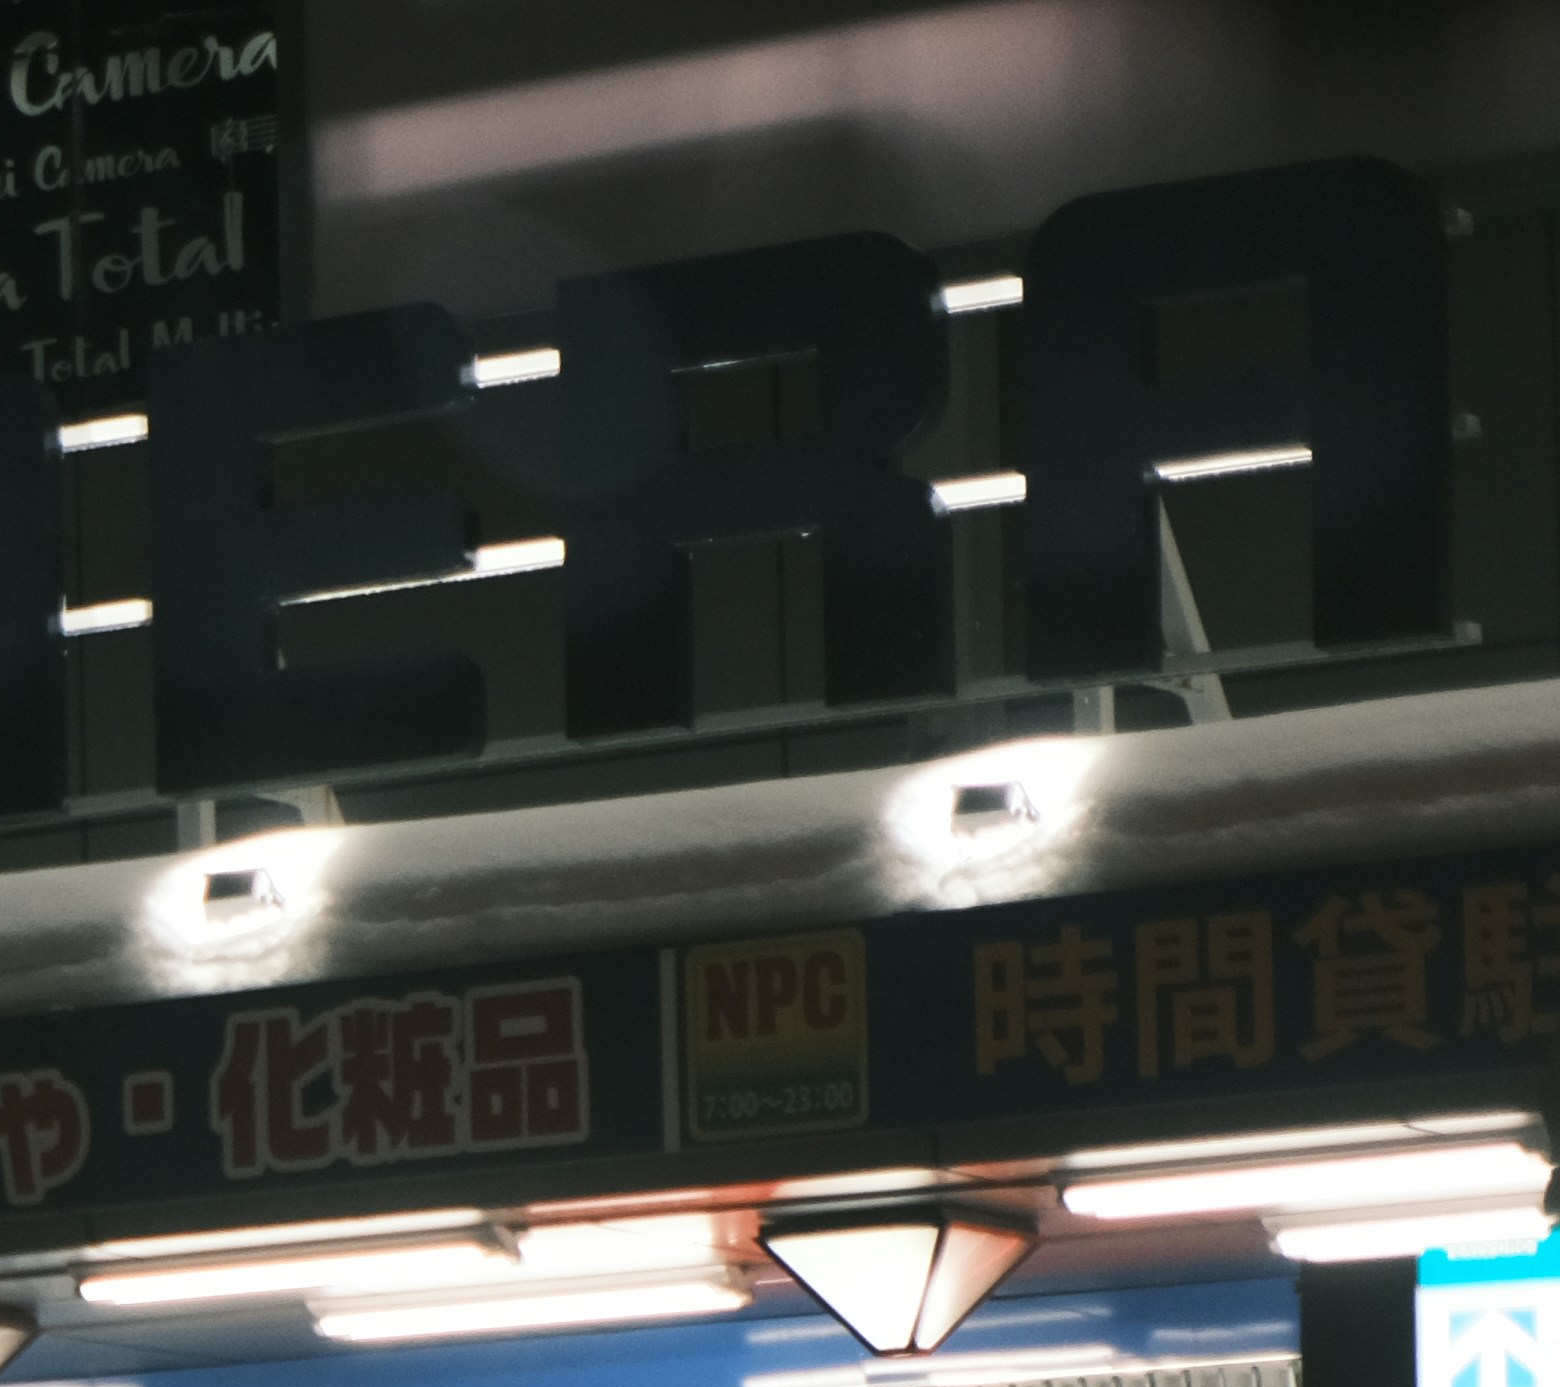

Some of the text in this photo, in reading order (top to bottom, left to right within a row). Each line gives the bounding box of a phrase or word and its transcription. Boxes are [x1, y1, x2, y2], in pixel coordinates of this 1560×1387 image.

[10, 31, 278, 117] Camera
[35, 144, 181, 191] Camera
[33, 190, 244, 300] Total
[21, 326, 130, 382] Total
[703, 951, 848, 1042] NPC
